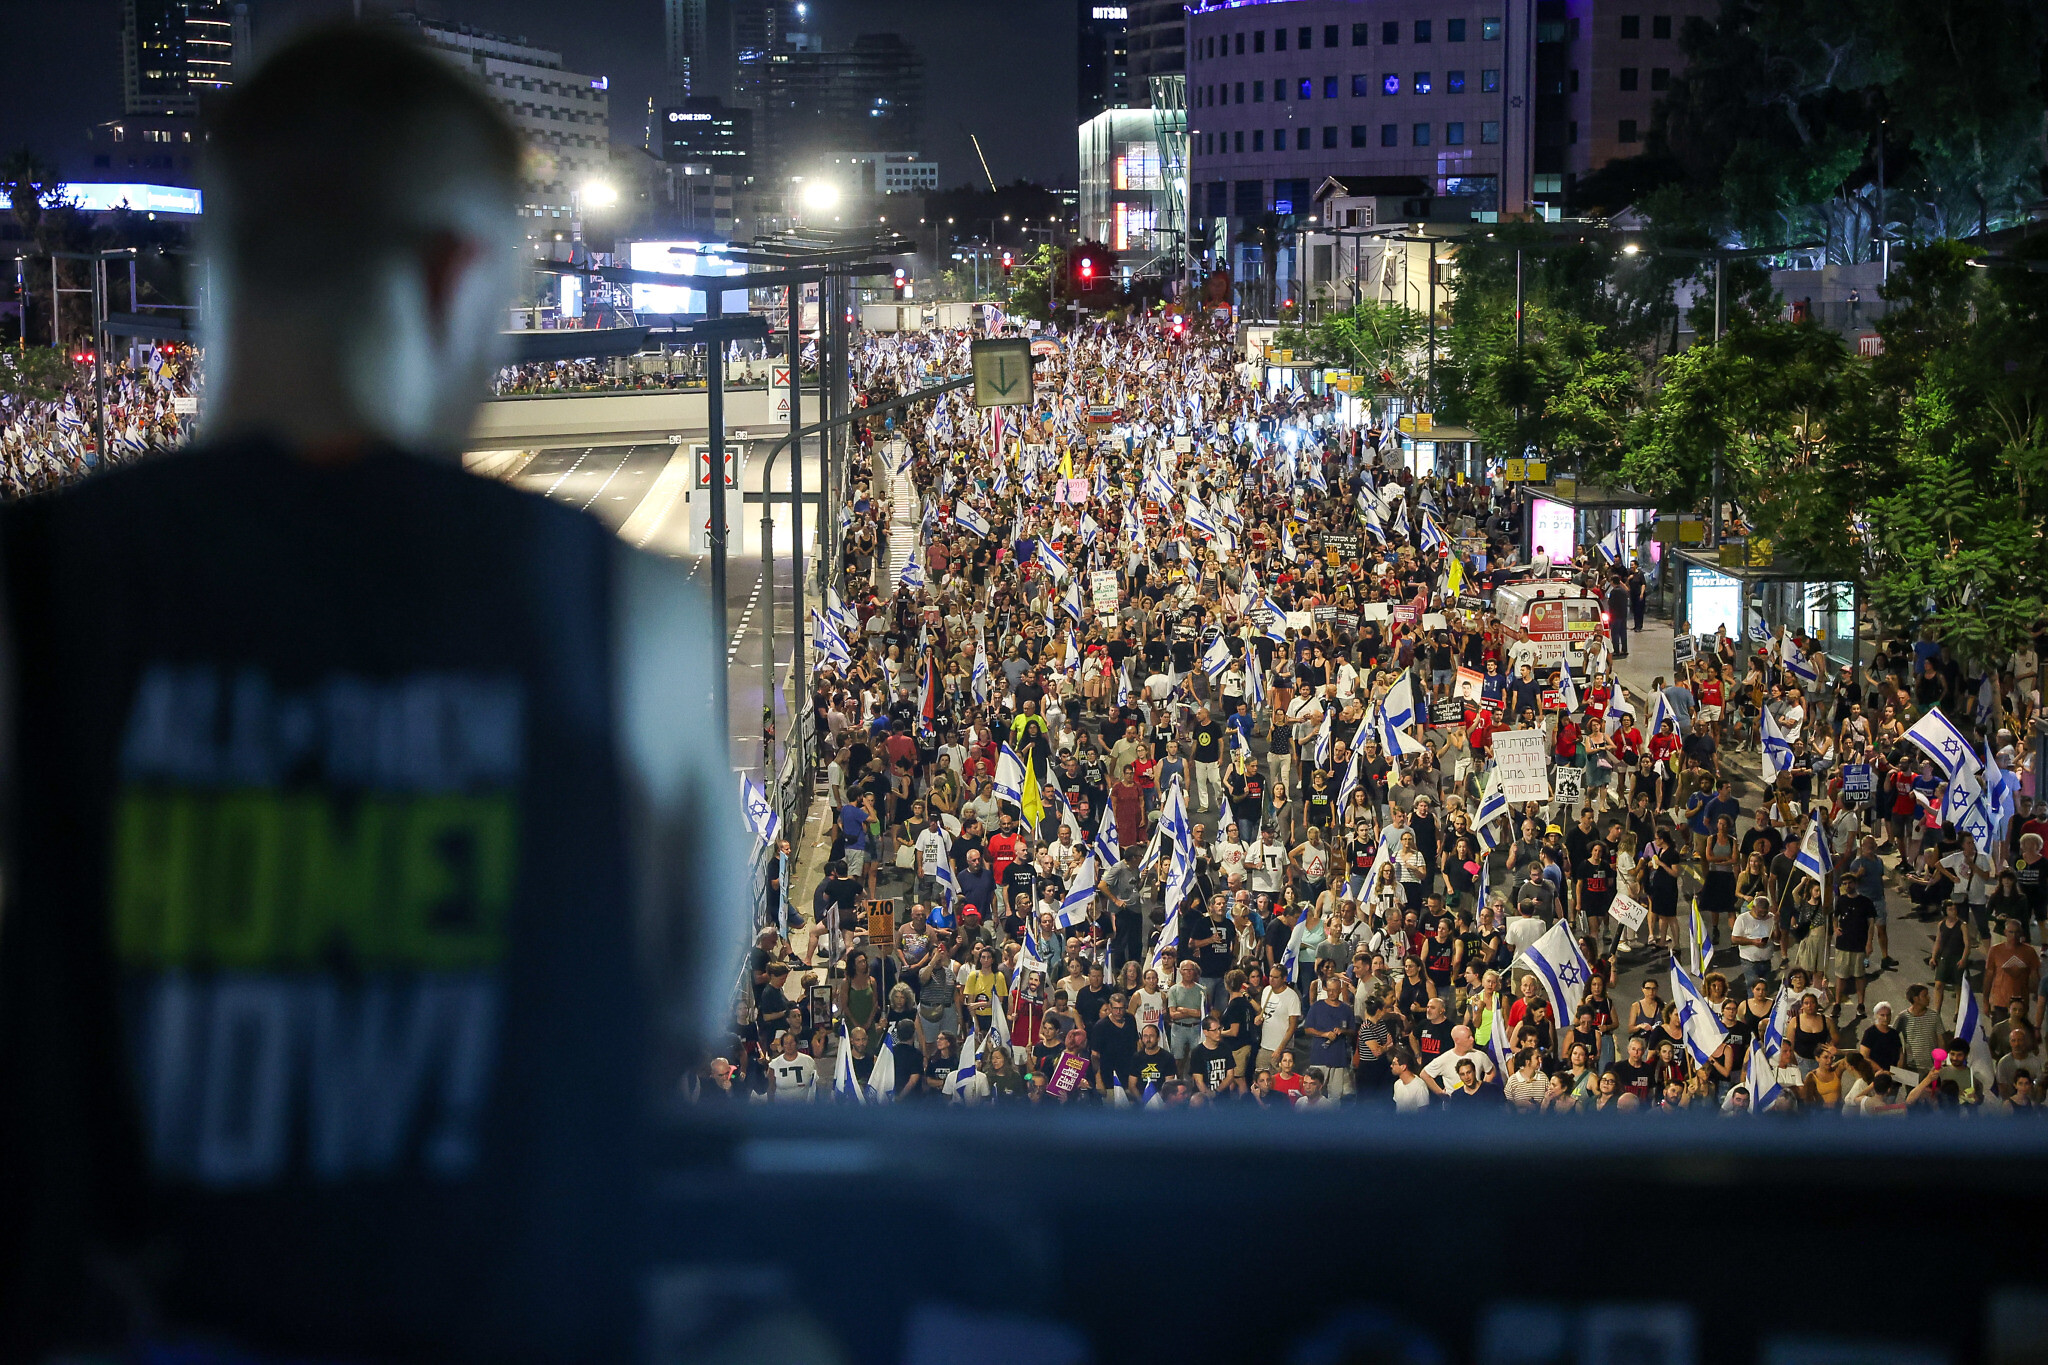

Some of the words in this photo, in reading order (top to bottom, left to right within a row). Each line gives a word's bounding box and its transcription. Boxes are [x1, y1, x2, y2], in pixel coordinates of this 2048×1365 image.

[678, 113, 693, 121] ONE
[694, 113, 711, 121] ZERO
[1846, 791, 1869, 801] עכשיו
[868, 901, 893, 915] 7.10
[779, 1066, 803, 1083] די
